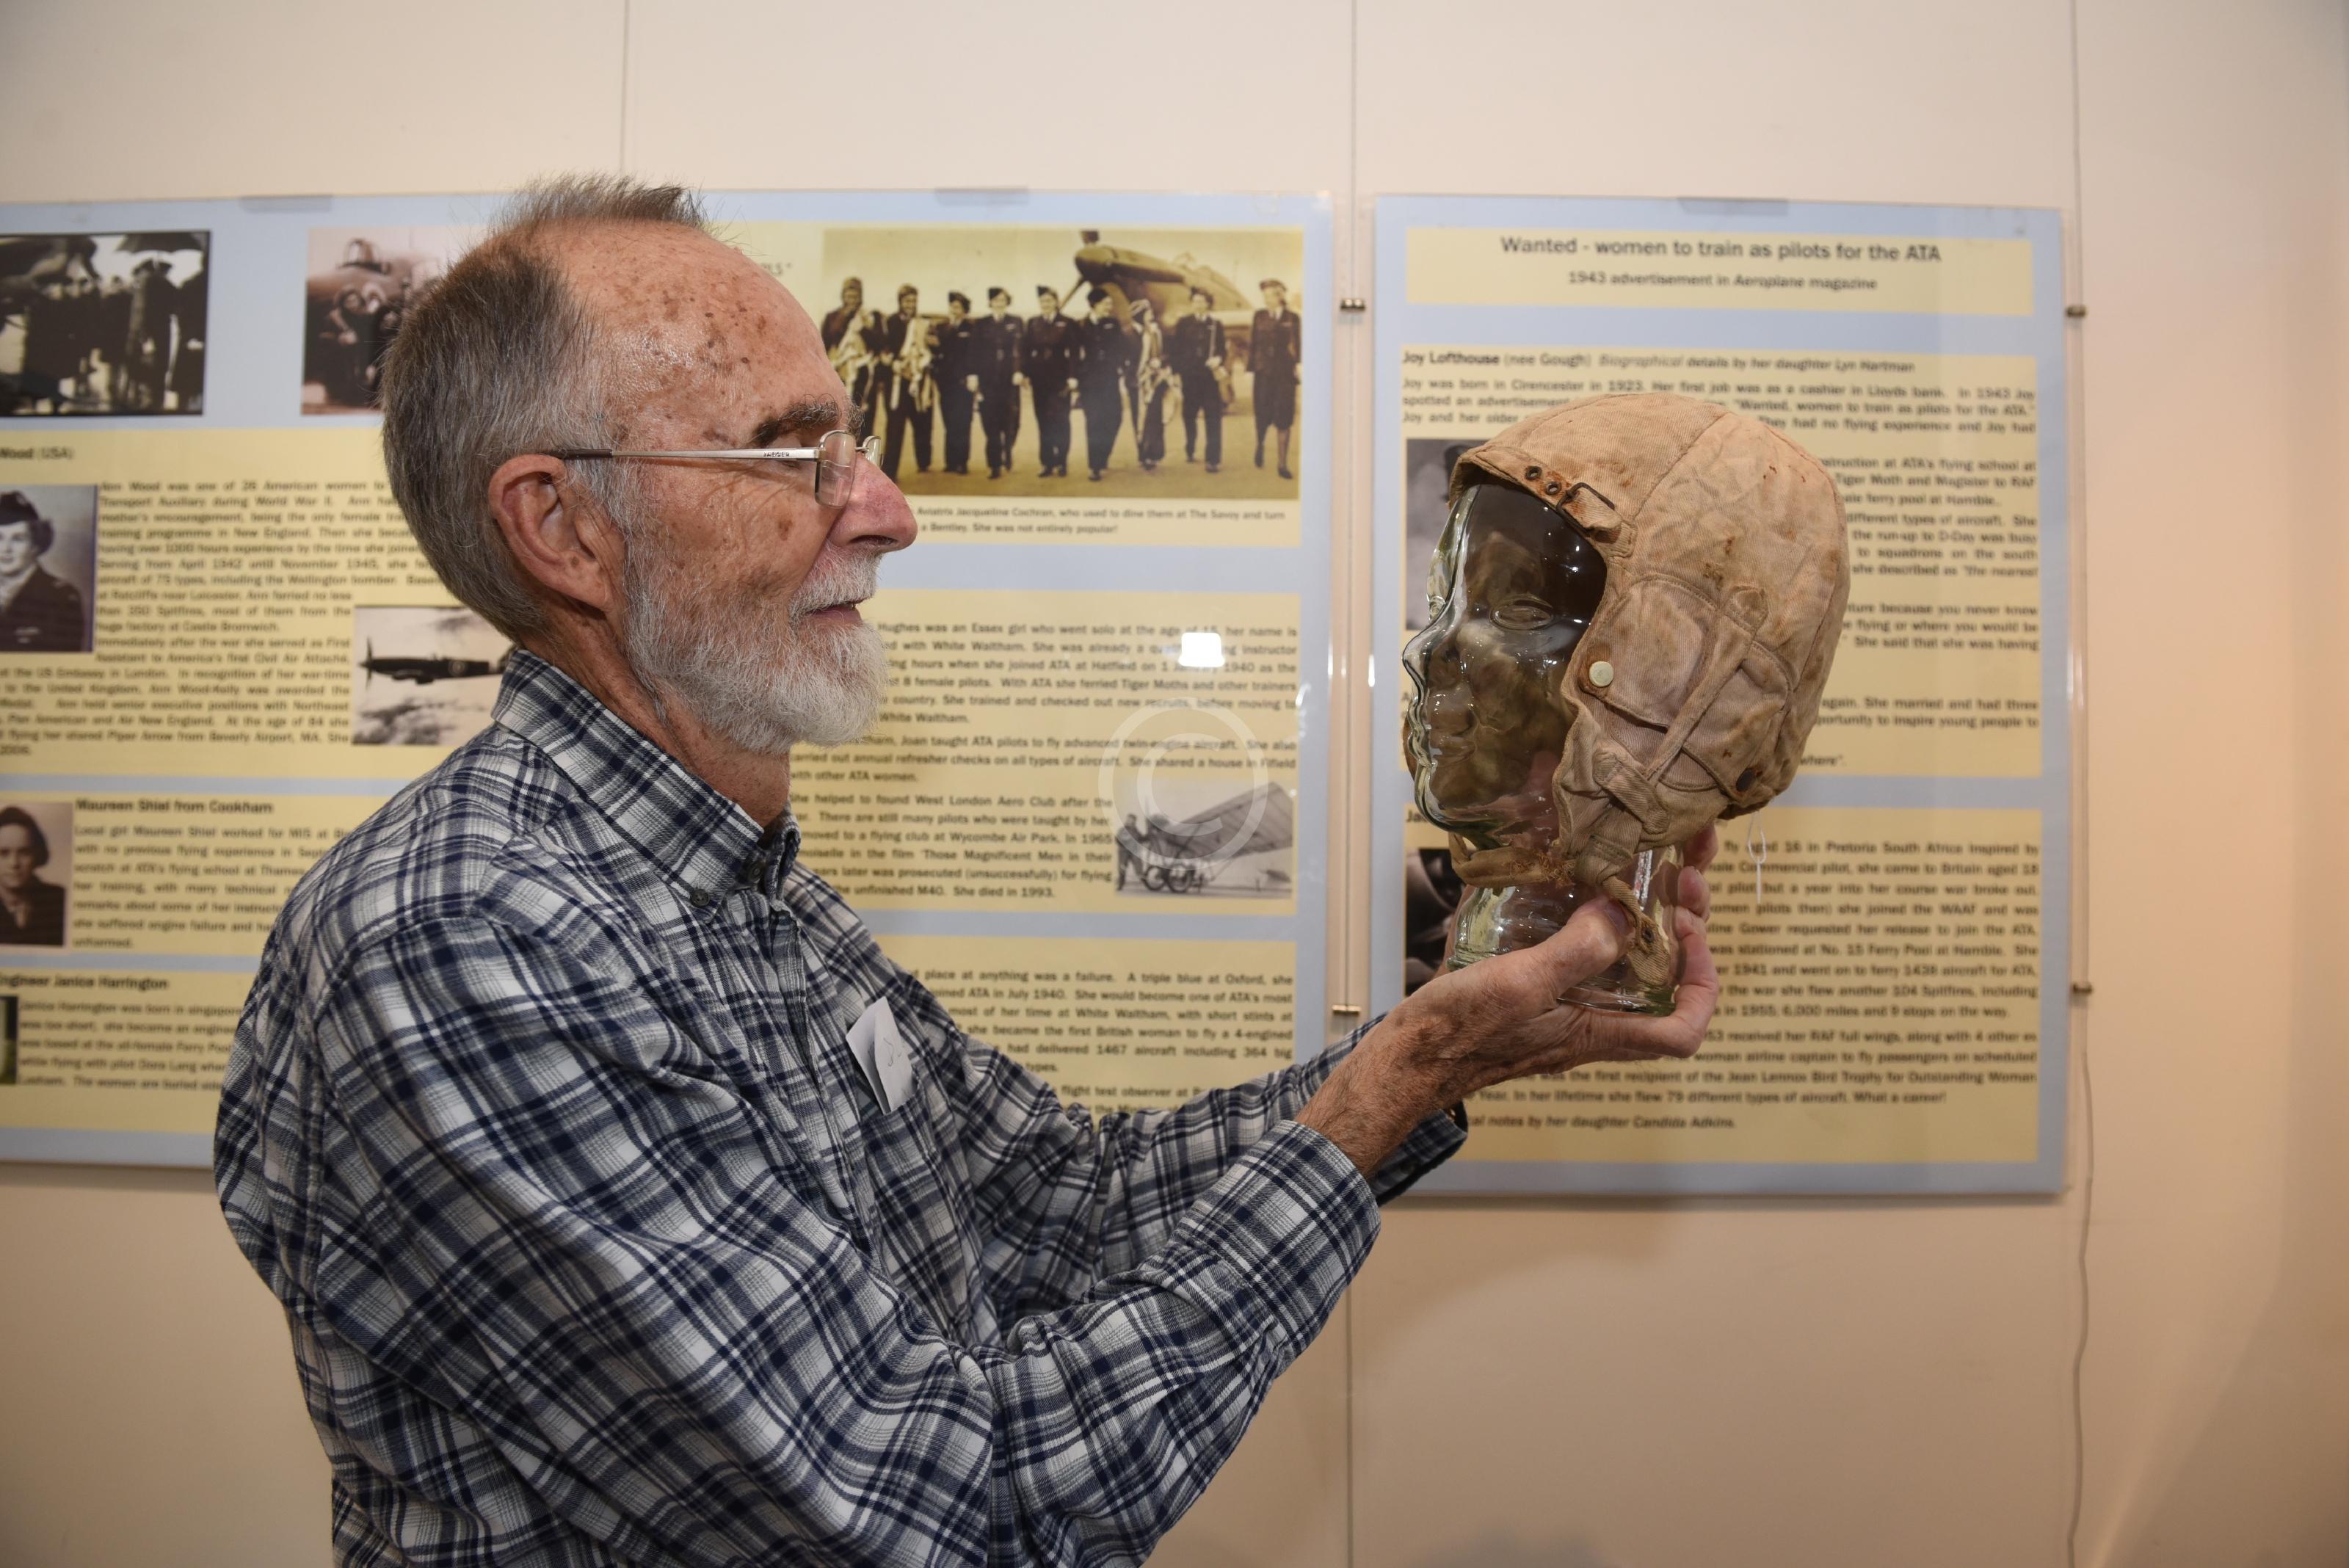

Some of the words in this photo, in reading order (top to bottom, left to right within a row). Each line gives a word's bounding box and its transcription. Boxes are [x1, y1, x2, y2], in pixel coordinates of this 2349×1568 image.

[1499, 237, 1578, 254] Wanted
[1594, 242, 1669, 255] women
[1671, 242, 1693, 255] to
[1696, 242, 1744, 257] train
[1748, 244, 1773, 258] as
[1776, 242, 1832, 261] pilots
[1834, 244, 1864, 260] for
[1867, 244, 1901, 261] the
[1903, 244, 1942, 261] ATA
[1568, 270, 1608, 285] 1943
[1608, 273, 1714, 287] advertisement
[1715, 277, 1731, 286] in
[1732, 274, 1807, 290] Aeroplane
[1807, 277, 1878, 292] magazine
[1403, 351, 1424, 367] Joy
[1428, 352, 1501, 366] Lofthouse
[1598, 352, 1682, 369] Biographical
[1685, 357, 1730, 368] details
[1731, 358, 1749, 369] by
[1749, 358, 1773, 368] her
[1773, 359, 1832, 372] daughter
[1834, 361, 1857, 371] Lyn
[1859, 361, 1916, 372] Hartman
[1403, 379, 1422, 390] Joy
[1428, 380, 1455, 388] was
[1459, 379, 1489, 390] born
[1511, 380, 1584, 391] Cirencester
[1651, 380, 1674, 392] Her
[1680, 382, 1705, 392] first
[1709, 382, 1731, 394] job
[1735, 385, 1762, 393] was
[1765, 385, 1782, 394] as
[1799, 384, 1845, 395] cashier
[1867, 386, 1908, 398] Lloyds
[1911, 387, 1945, 398] bank.
[1977, 388, 2011, 399] 1943
[956, 508, 1009, 518] Jacqueline
[1122, 509, 1144, 518] dine
[1189, 509, 1208, 519] The
[1210, 510, 1240, 519] Savoy
[1242, 511, 1262, 520] and
[929, 523, 968, 532] Bentley.
[972, 523, 992, 531] She
[1035, 525, 1073, 533] entirely
[924, 625, 948, 633] was
[951, 625, 967, 633] an
[971, 623, 1003, 633] Essex
[1008, 625, 1026, 636] girl
[1031, 625, 1055, 634] who
[1059, 625, 1087, 634] went
[1091, 625, 1116, 635] solo
[1136, 626, 1155, 634] the
[1160, 626, 1181, 637] age
[1854, 636, 1878, 647] She
[1882, 637, 1909, 647] said
[1913, 638, 1938, 648] that
[1942, 638, 1964, 648] she
[1969, 640, 1994, 650] was
[1998, 639, 2038, 651] having
[914, 677, 956, 687] female
[957, 678, 992, 689] pilots.
[1000, 678, 1028, 688] With
[1030, 678, 1053, 687] ATA
[1055, 679, 1077, 688] she
[1079, 679, 1119, 689] ferried
[1121, 678, 1150, 691] Tiger
[1152, 679, 1190, 690] Moths
[1191, 681, 1215, 690] and
[1217, 681, 1249, 691] other
[1252, 682, 1297, 691] trainers
[76, 799, 134, 811] Maureen
[174, 801, 205, 812] from
[209, 800, 272, 813] Cookham
[853, 885, 915, 896] unfinished
[953, 886, 976, 896] She
[978, 887, 1004, 896] died
[1021, 888, 1054, 898] 1993.
[1708, 945, 1735, 954] was
[1737, 944, 1799, 956] stationed
[1802, 945, 1817, 955] at
[1819, 944, 1840, 955] No.
[1867, 943, 1900, 956] Ferry
[1903, 943, 1933, 955] Pool
[2014, 945, 2039, 956] She
[54, 973, 95, 988] Janice
[98, 975, 169, 992] Harrington
[923, 970, 957, 981] place
[960, 971, 974, 980] at
[978, 970, 1030, 983] anything
[1033, 973, 1059, 981] was
[1075, 972, 1117, 982] failure.
[1140, 973, 1173, 984] triple
[1176, 974, 1204, 984] blue
[1207, 975, 1221, 984] at
[1224, 974, 1267, 984] Oxford,
[1271, 976, 1294, 985] she
[1487, 1116, 1525, 1127] notes
[1526, 1117, 1543, 1129] by
[1545, 1117, 1568, 1127] her
[1570, 1116, 1630, 1130] daughter
